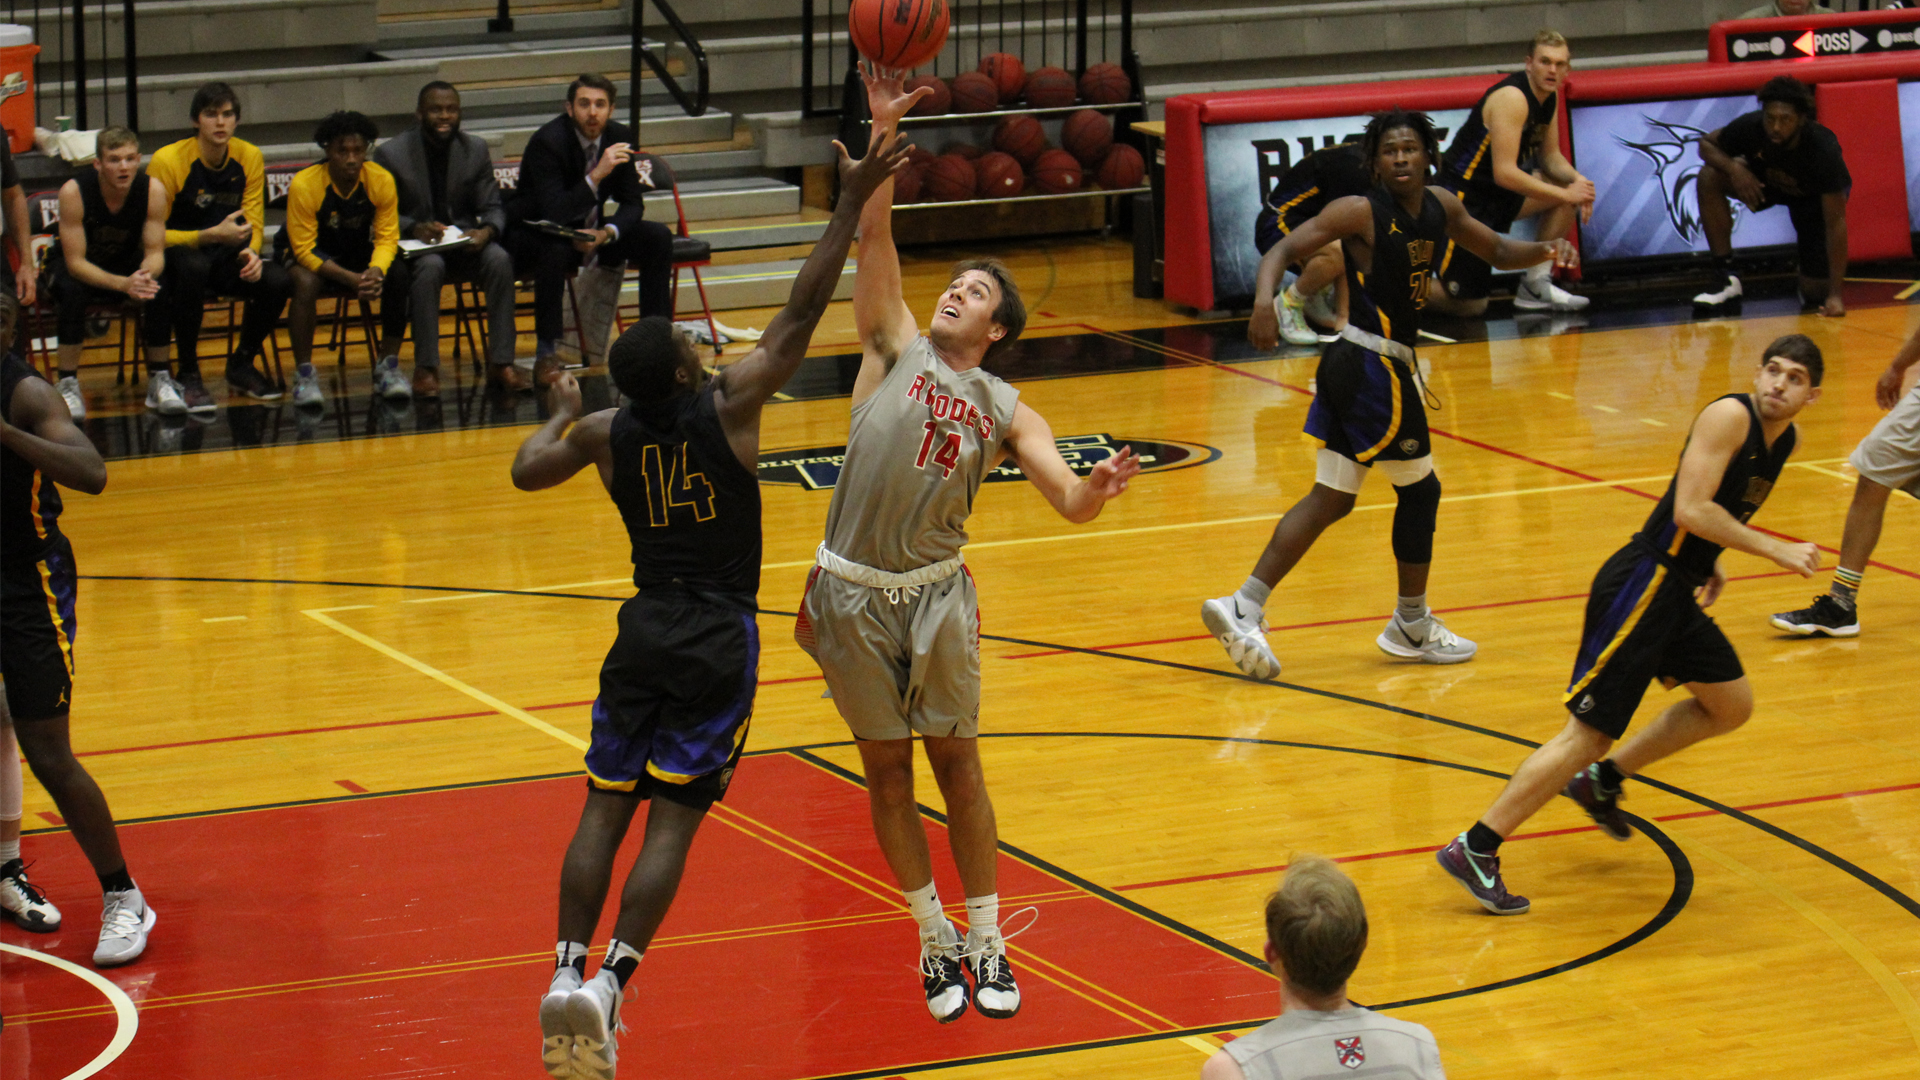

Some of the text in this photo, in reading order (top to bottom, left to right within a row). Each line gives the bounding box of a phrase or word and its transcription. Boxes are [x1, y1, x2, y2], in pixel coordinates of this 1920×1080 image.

[1814, 32, 1850, 52] POSS
[906, 373, 995, 441] RHODES
[914, 420, 963, 480] 14
[641, 441, 716, 527] 14
